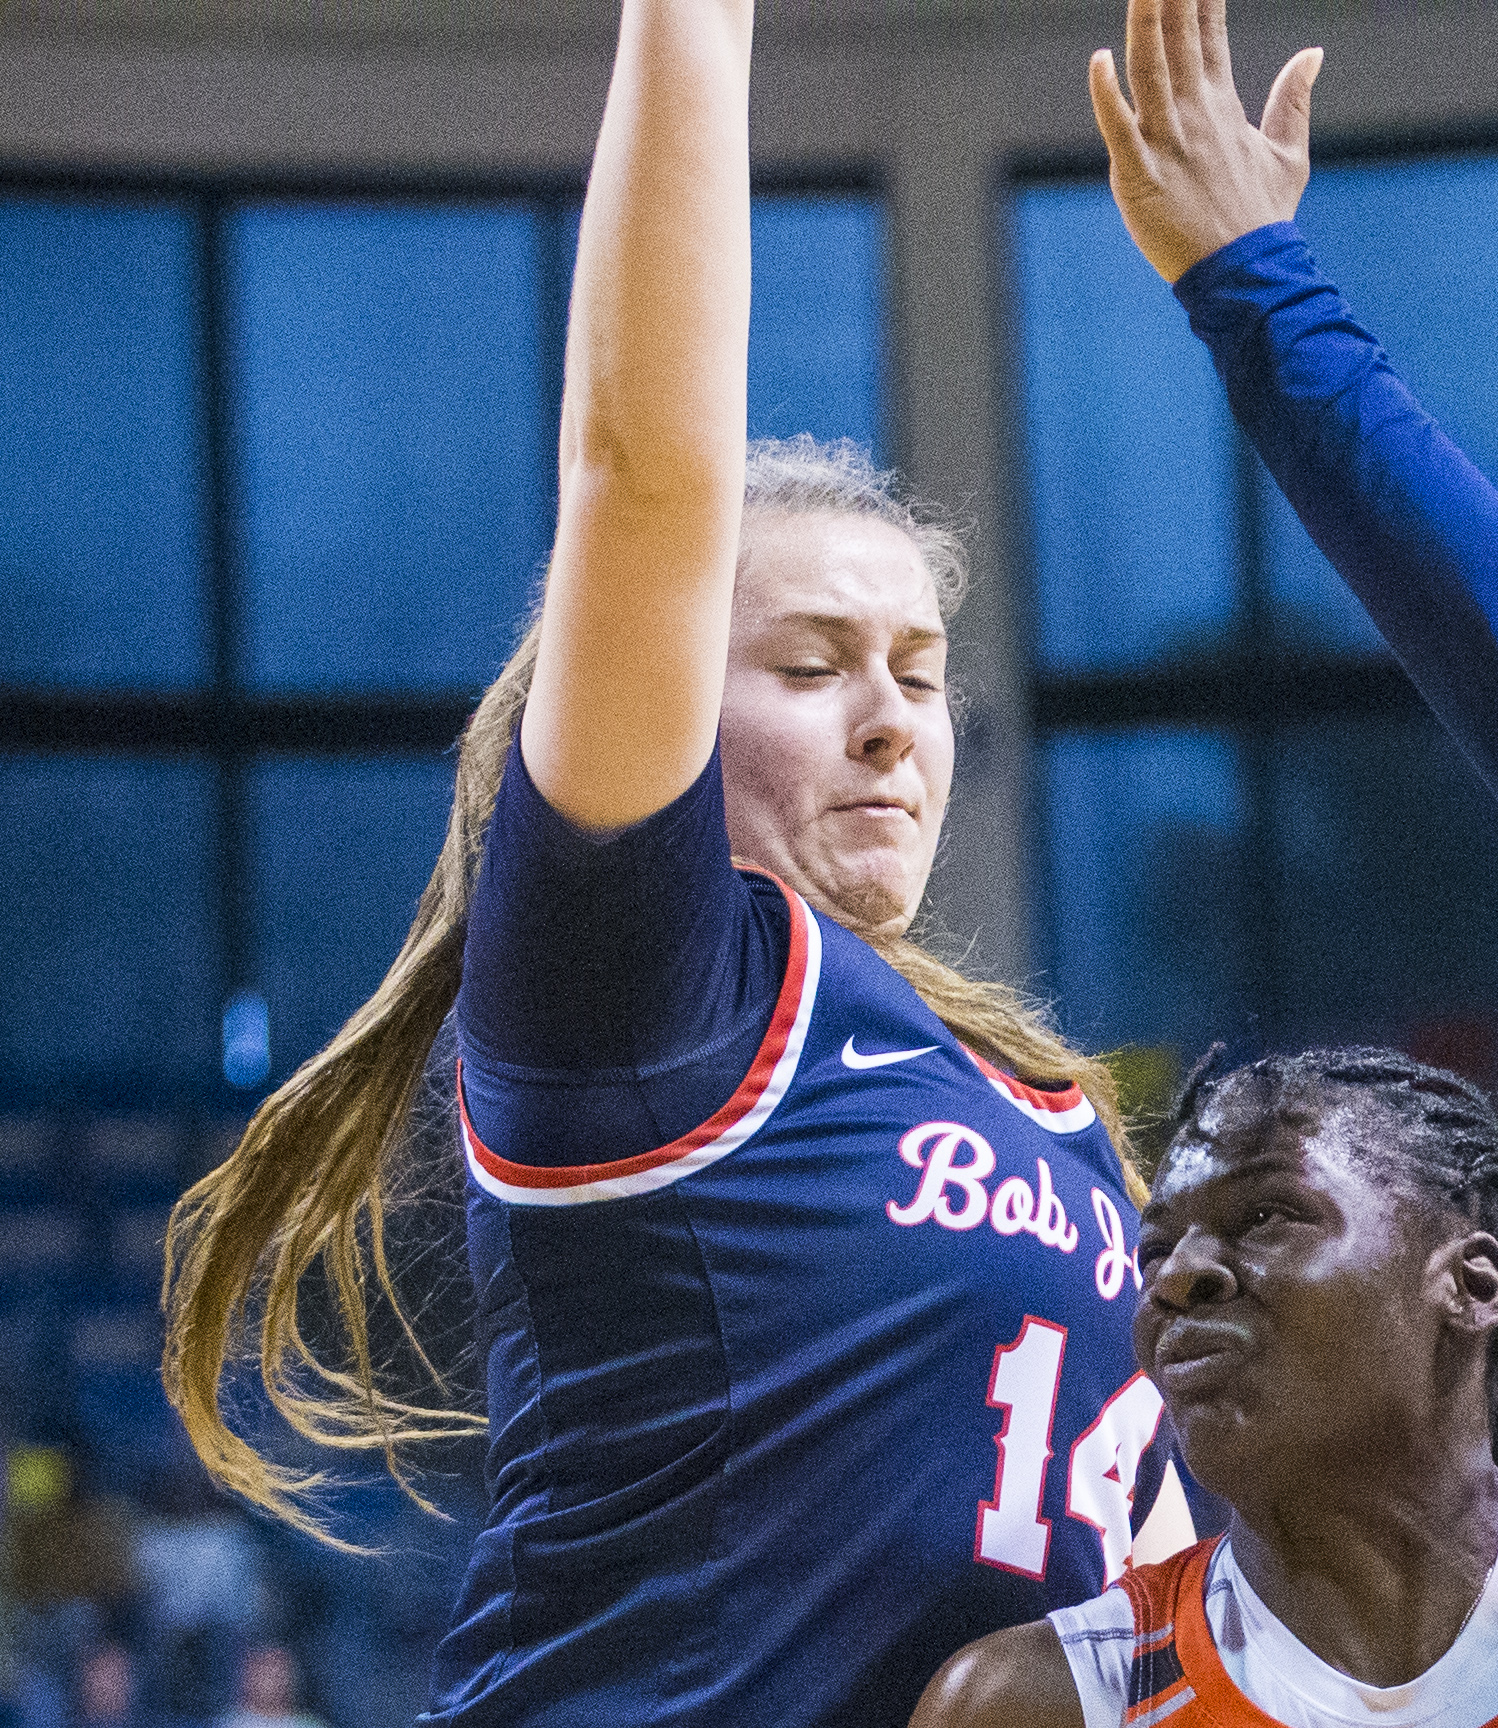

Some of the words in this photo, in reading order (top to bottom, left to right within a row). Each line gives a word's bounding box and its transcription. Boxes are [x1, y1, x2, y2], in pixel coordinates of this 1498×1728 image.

[886, 1120, 1079, 1254] Bob
[1090, 1186, 1144, 1302] J
[974, 1314, 1166, 1594] 14
